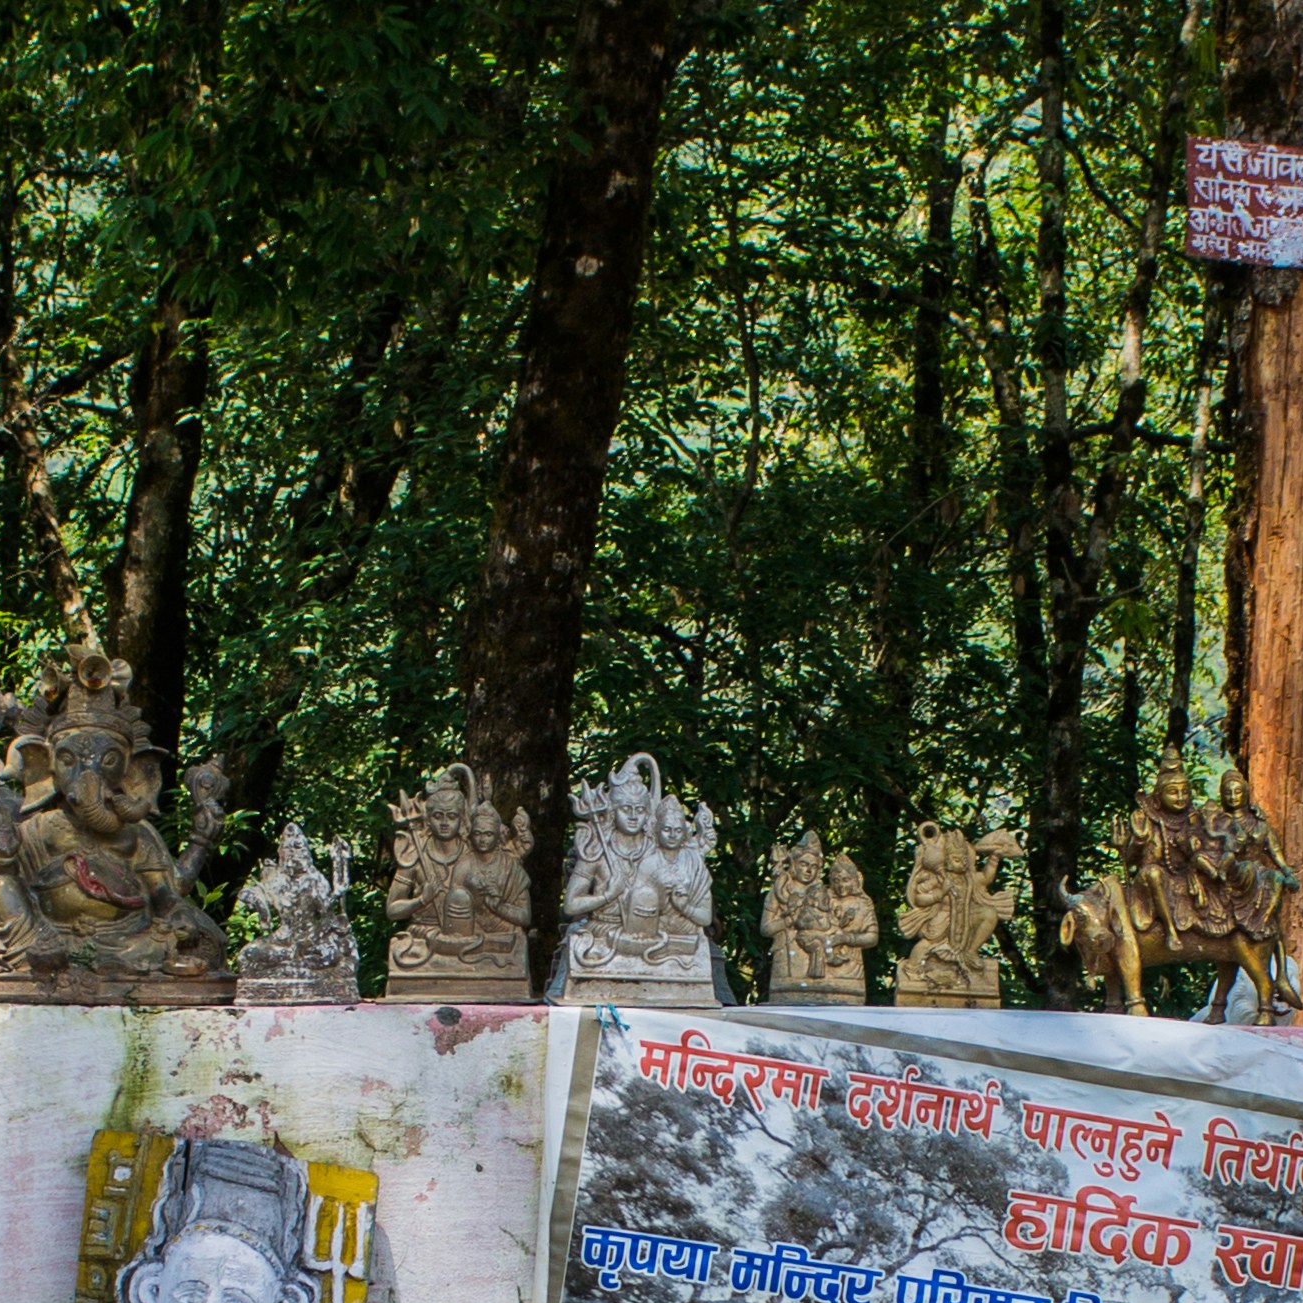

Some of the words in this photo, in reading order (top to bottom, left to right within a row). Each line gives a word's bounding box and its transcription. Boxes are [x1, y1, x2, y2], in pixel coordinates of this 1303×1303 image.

[640, 1029, 829, 1113] मन्दिरमा
[848, 1067, 1000, 1140] दर्शनार्थ
[1023, 1104, 1182, 1182] पाल्नुहुने
[583, 1226, 718, 1290] कृपया
[1004, 1185, 1198, 1267] हार्दिक
